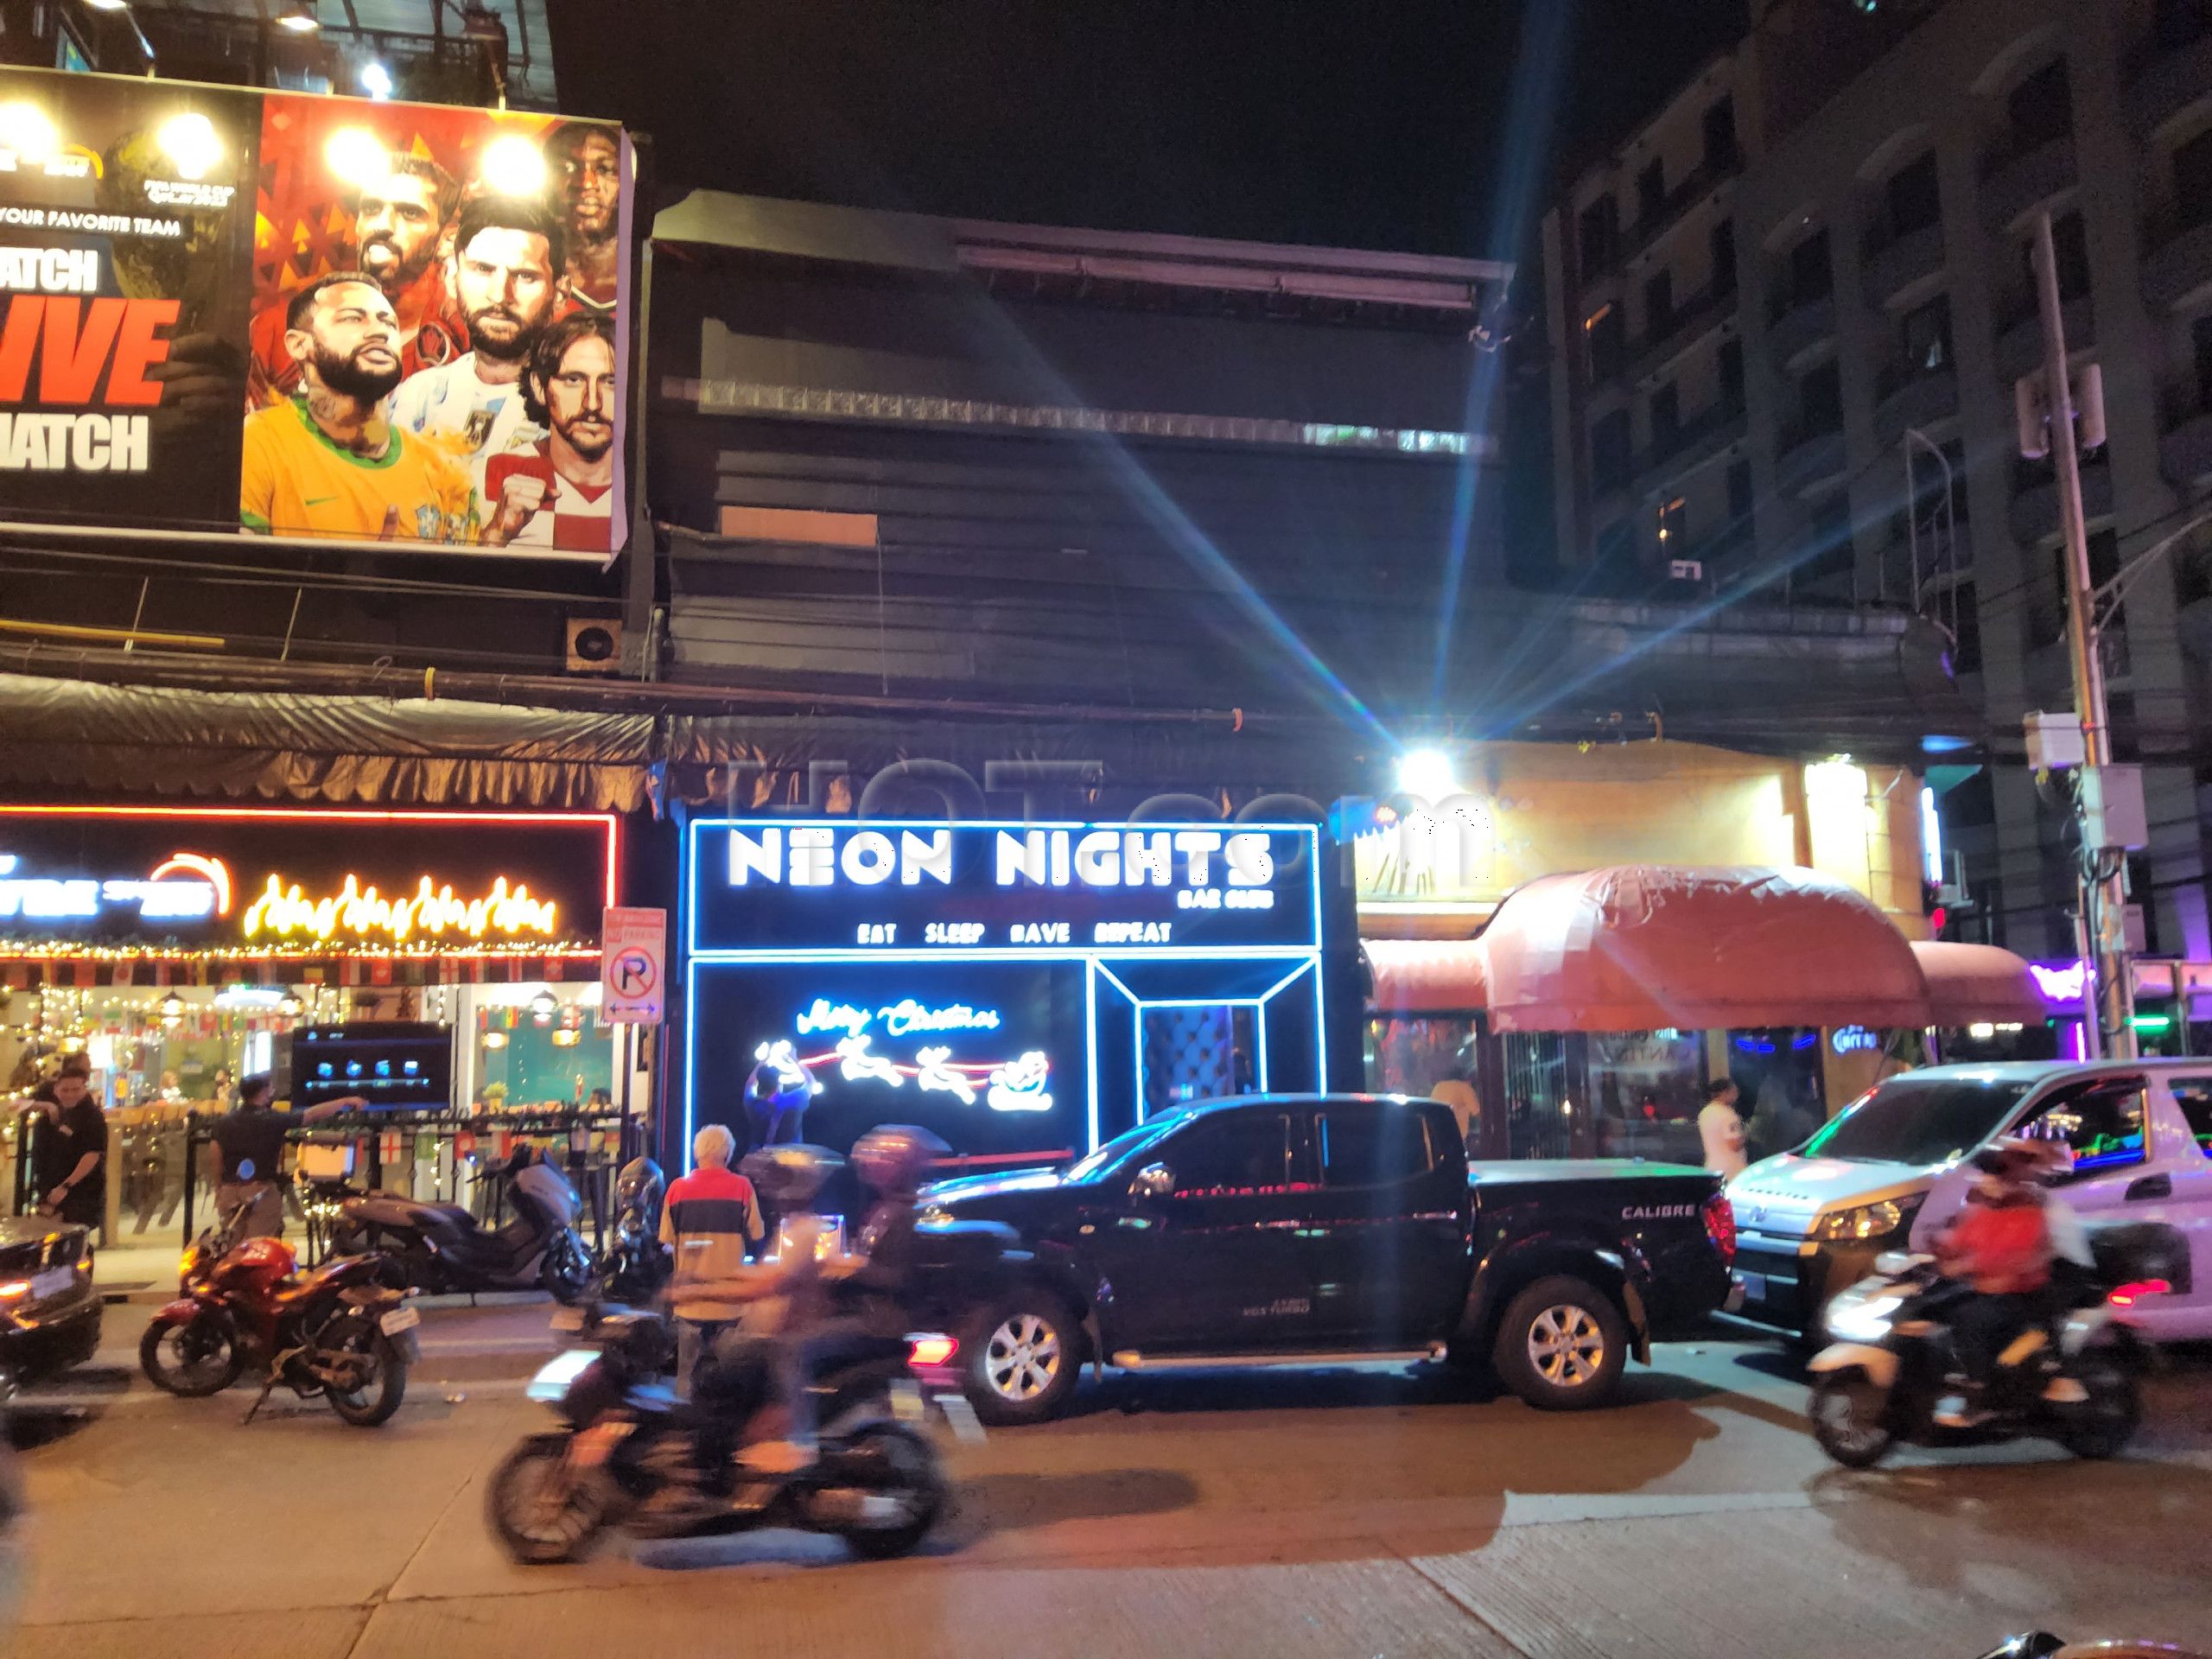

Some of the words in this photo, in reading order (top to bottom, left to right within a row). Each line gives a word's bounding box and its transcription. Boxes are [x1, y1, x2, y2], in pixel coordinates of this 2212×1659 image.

[0, 207, 44, 225] YOUR
[48, 211, 130, 232] FAVORITE
[133, 218, 181, 237] TEAM
[0, 247, 99, 291] ATCH
[0, 295, 181, 406] IVE
[729, 827, 951, 886] NEON
[996, 830, 1274, 887] NIGHTS
[856, 923, 897, 944] EAT
[924, 922, 986, 944] SLEEP
[1010, 922, 1071, 944] RAVE
[1094, 921, 1173, 944] REPEAT
[1622, 1204, 1695, 1220] CALIBRE
